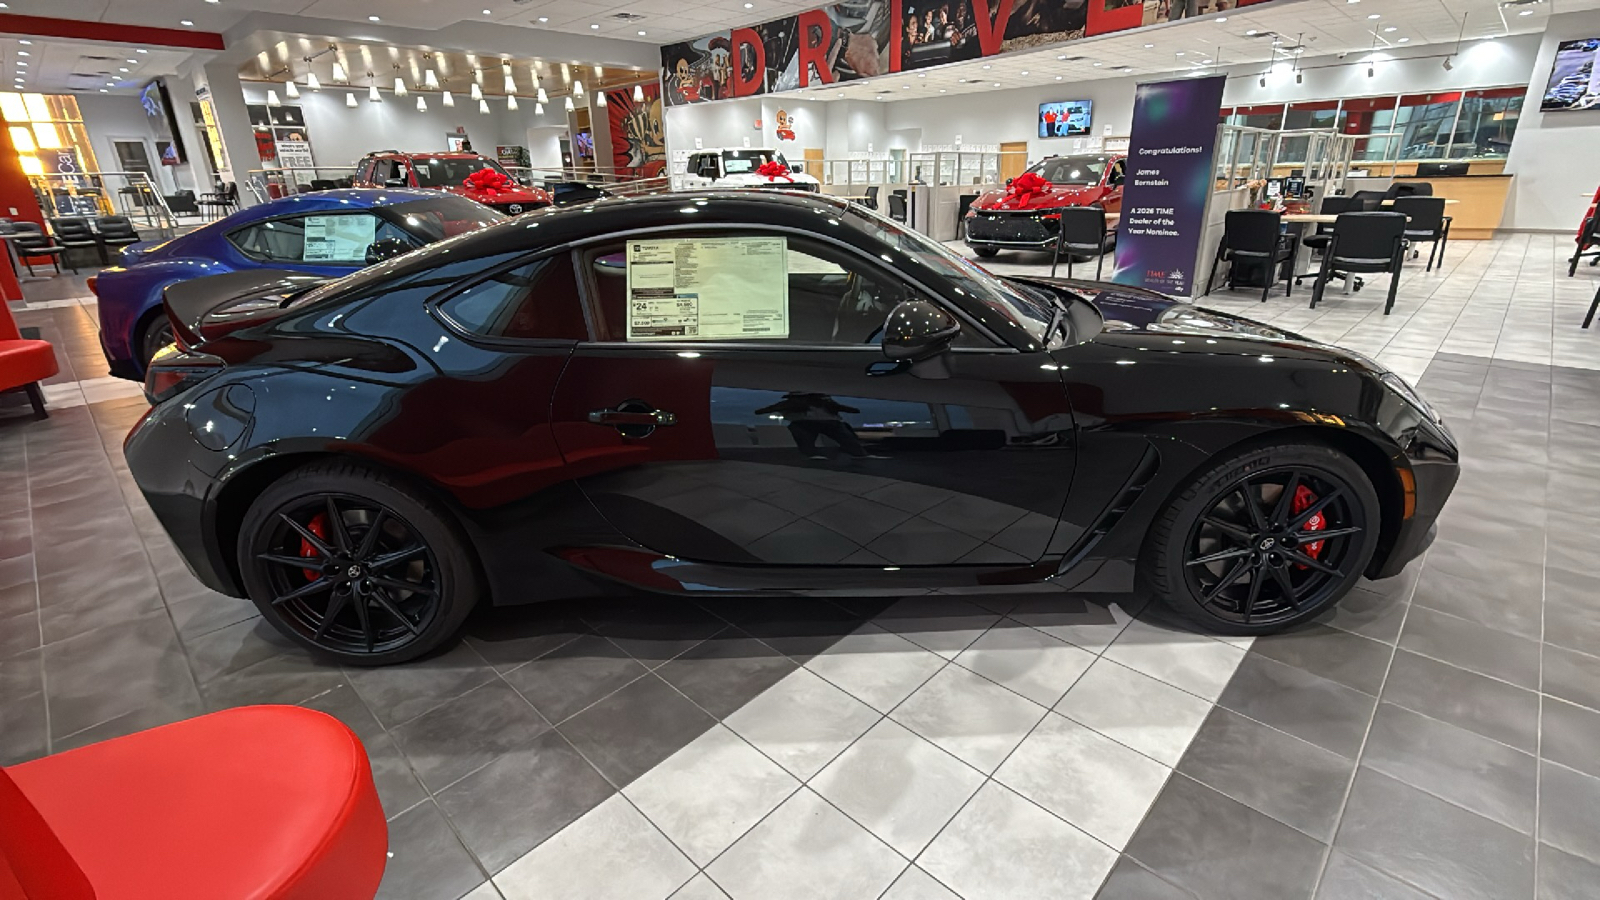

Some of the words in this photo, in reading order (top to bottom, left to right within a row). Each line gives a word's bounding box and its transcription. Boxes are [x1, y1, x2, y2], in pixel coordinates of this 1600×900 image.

[1138, 146, 1203, 156] Congratulations!
[281, 156, 312, 167] FREE
[1134, 178, 1169, 186] Bernstein
[1161, 218, 1175, 226] the
[1145, 228, 1180, 236] Nominee.
[636, 302, 647, 310] 24
